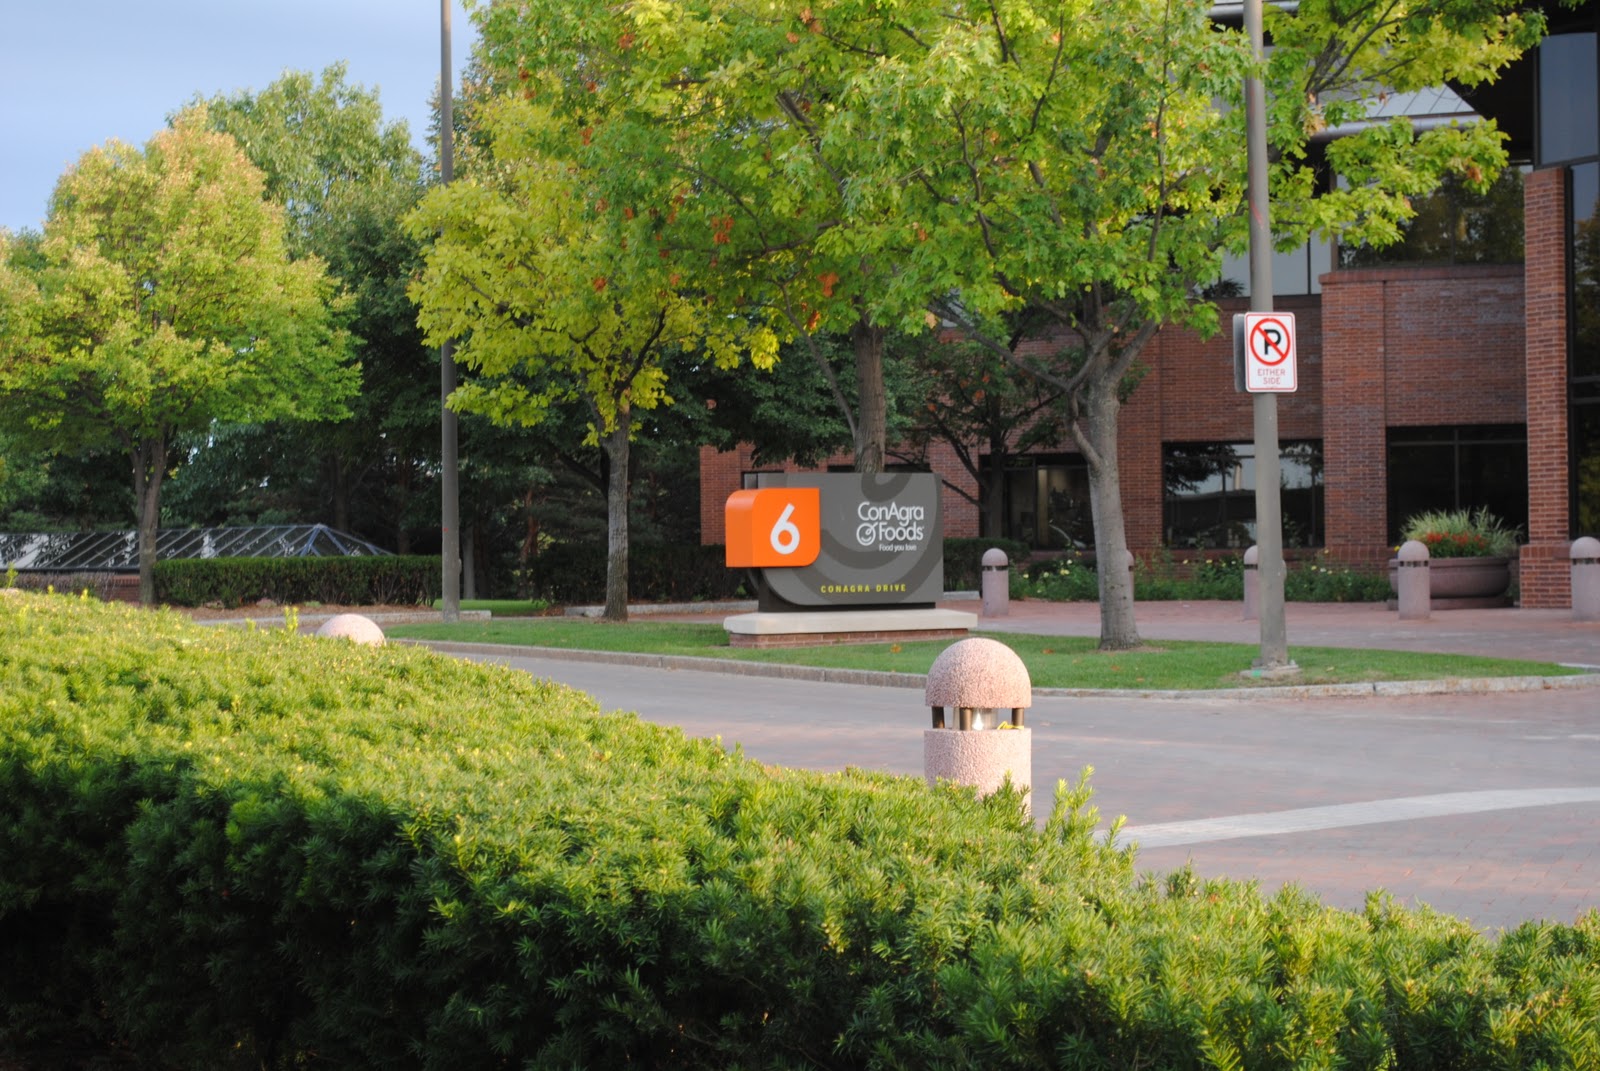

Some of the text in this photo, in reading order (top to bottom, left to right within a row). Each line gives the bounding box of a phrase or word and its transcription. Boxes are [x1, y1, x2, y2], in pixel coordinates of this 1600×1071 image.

[1264, 329, 1281, 355] P
[1258, 368, 1285, 377] EITHER
[1263, 377, 1281, 385] SIDE
[857, 502, 924, 526] ConAgra
[770, 503, 800, 554] 6
[878, 522, 923, 541] Foods
[879, 544, 893, 552] Food
[905, 544, 917, 552] love
[820, 584, 906, 593] CONAGRA DRIVE
